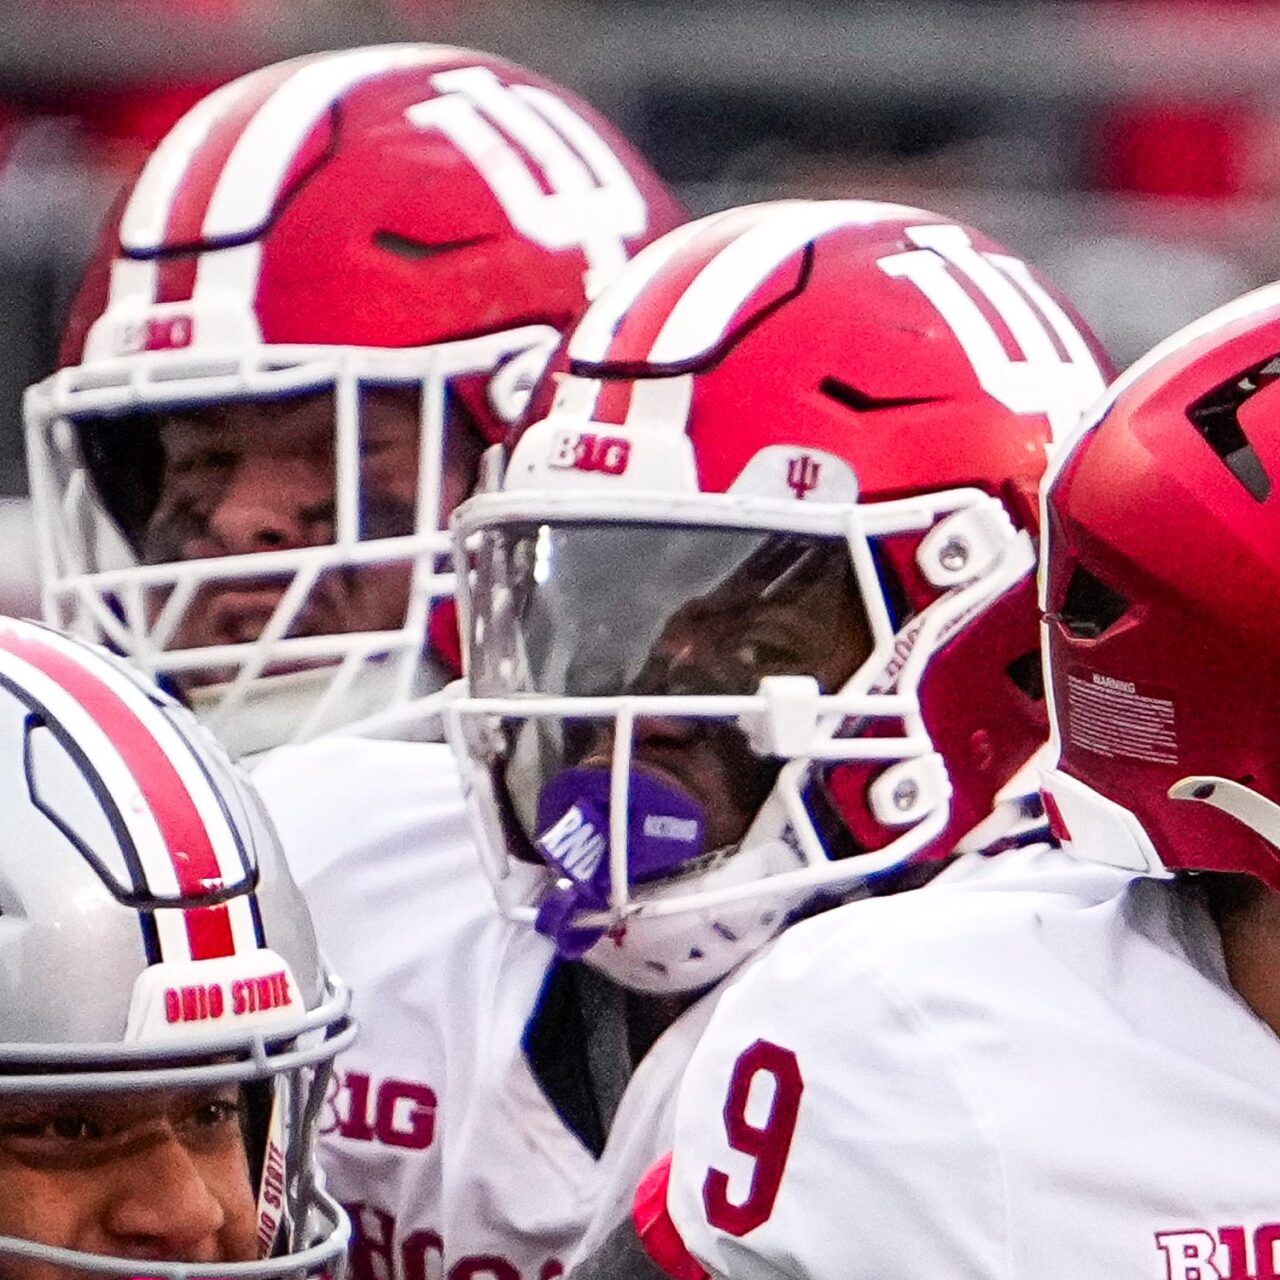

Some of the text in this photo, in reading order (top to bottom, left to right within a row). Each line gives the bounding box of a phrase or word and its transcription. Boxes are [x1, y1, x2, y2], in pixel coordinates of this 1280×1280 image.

[165, 971, 292, 1024] OHIO STATE
[702, 1038, 804, 1237] 9
